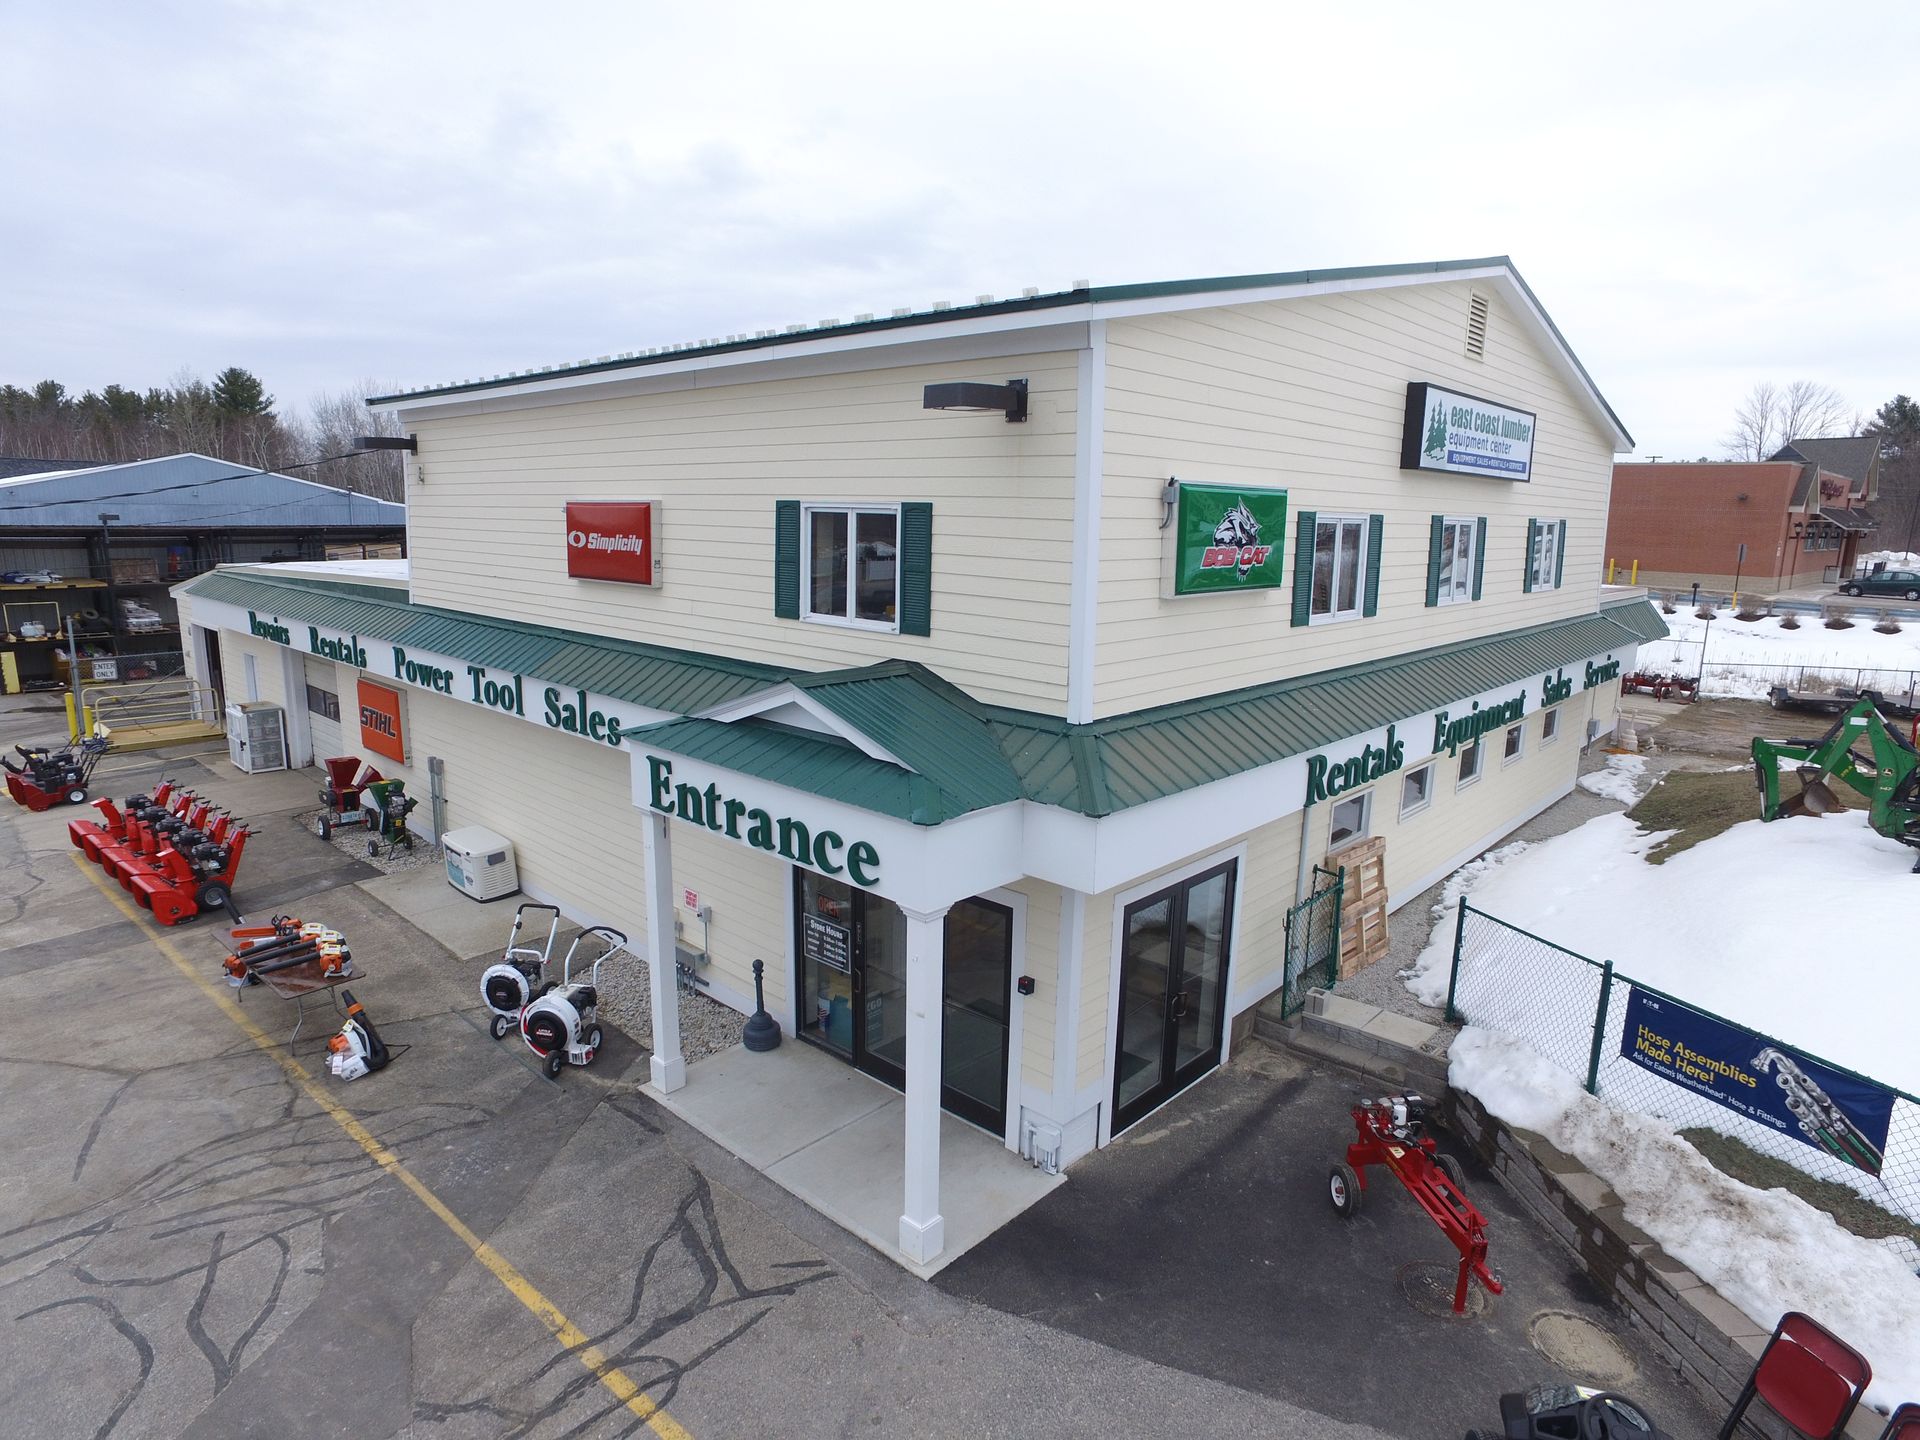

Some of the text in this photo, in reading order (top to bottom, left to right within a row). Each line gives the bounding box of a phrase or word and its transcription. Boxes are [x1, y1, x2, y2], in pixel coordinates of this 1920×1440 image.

[1448, 432, 1512, 455] equipment center
[1450, 406, 1531, 443] east coast lumber
[1452, 453, 1523, 471] EQUIPMENT SALES RENTALS SERVICE
[587, 532, 643, 556] Simplicity
[248, 610, 622, 746] Repairs Rentals Power Tool Sales
[360, 704, 397, 739] STIHL
[1304, 655, 1620, 808] Rentals Equipment Sales Service
[646, 755, 880, 887] Entrance
[1635, 1037, 1716, 1085] Made Here!
[1638, 1024, 1758, 1088] Hose Assemblies
[1632, 1051, 1644, 1062] Ask
[1644, 1055, 1653, 1067] for
[1653, 1060, 1676, 1079] Eaton's
[1728, 1095, 1747, 1111] Hose
[1748, 1105, 1756, 1115] &
[1756, 1109, 1787, 1129] Fittings
